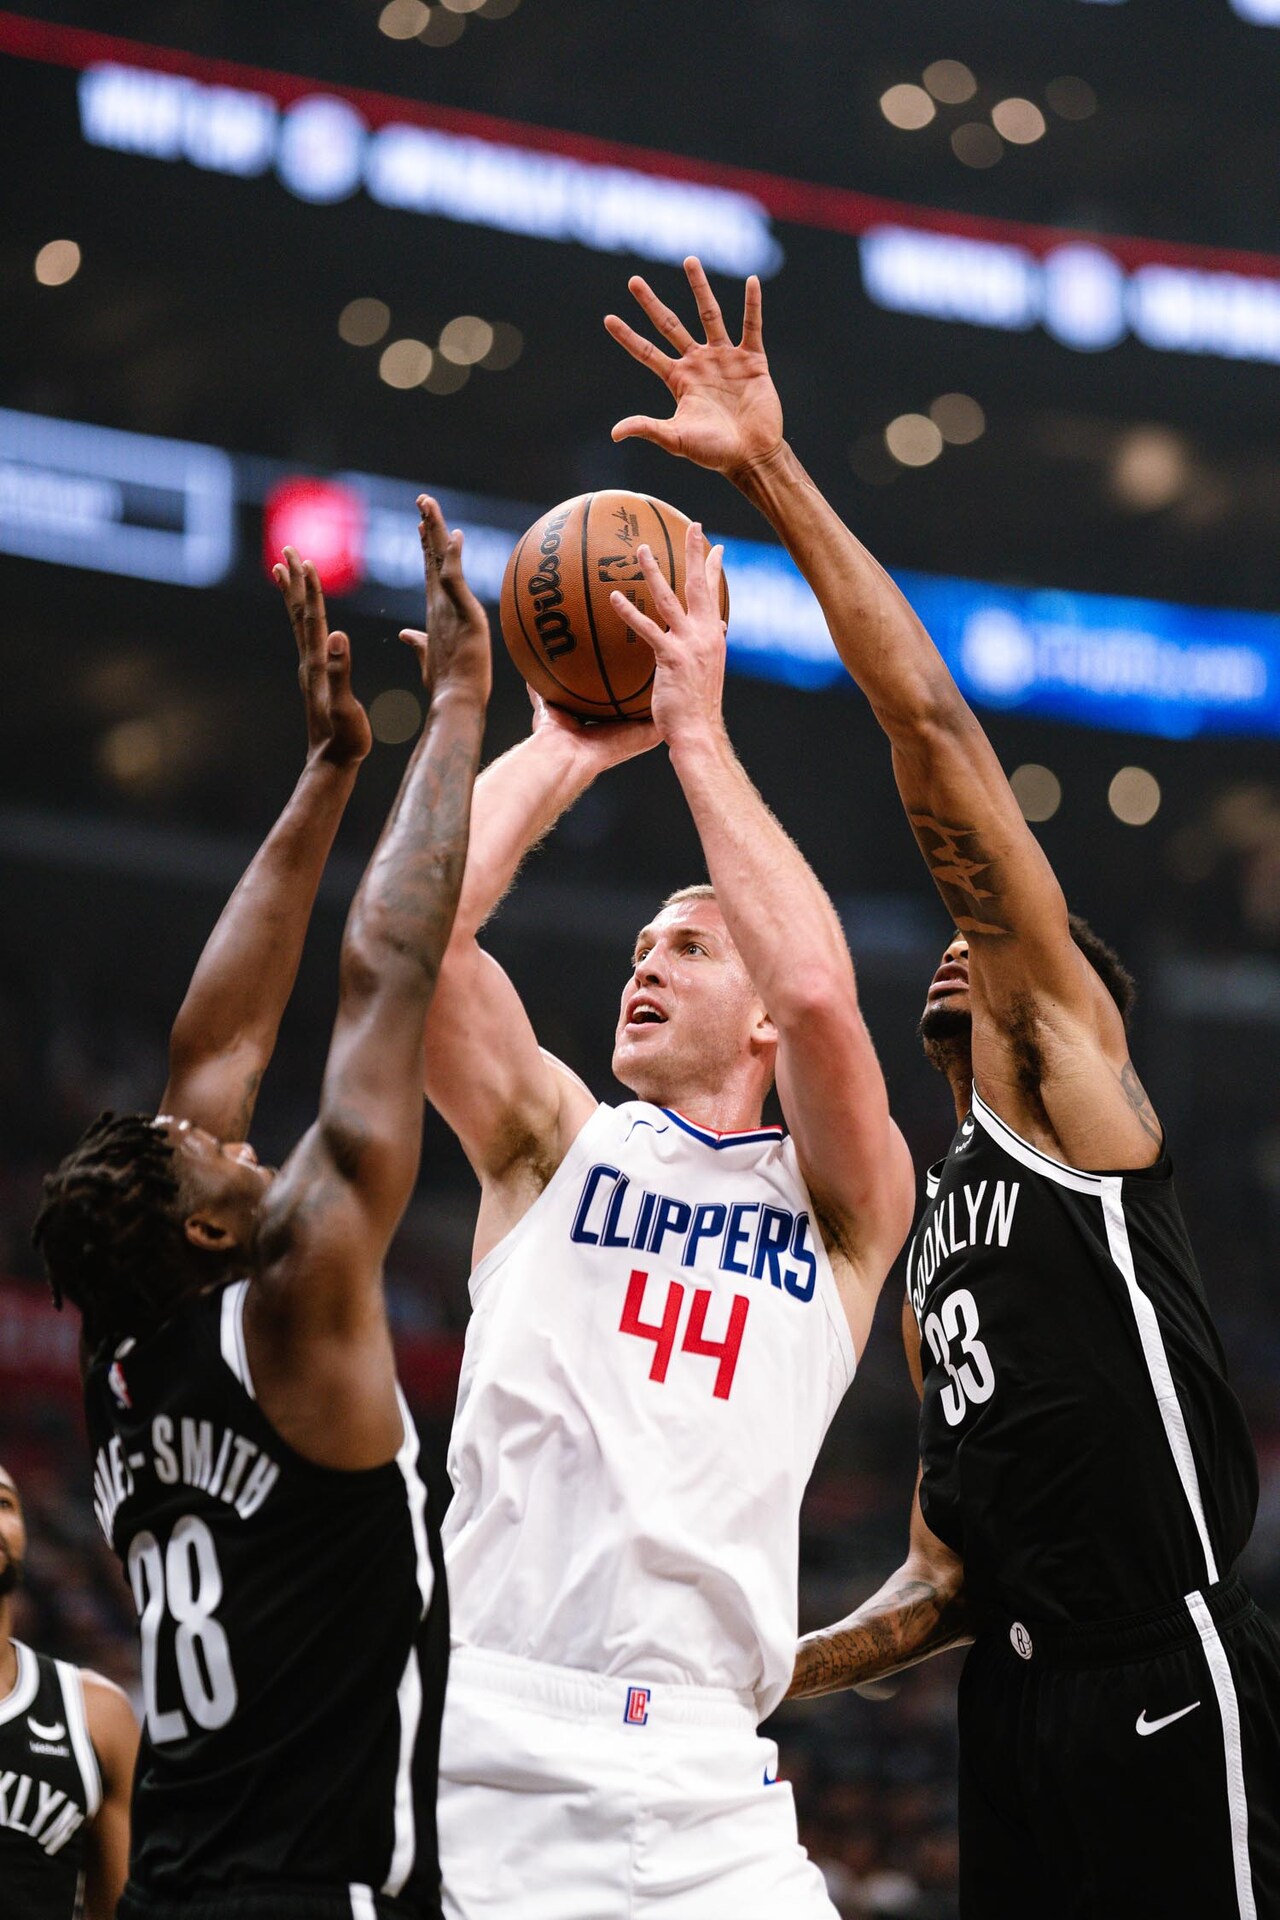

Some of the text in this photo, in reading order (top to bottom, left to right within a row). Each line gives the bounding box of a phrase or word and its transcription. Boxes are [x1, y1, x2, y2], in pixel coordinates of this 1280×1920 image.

[528, 511, 577, 661] Wilson
[570, 1163, 817, 1303] CLIPPERS
[619, 1269, 750, 1401] 44
[924, 1289, 996, 1426] 33
[128, 1515, 238, 1745] 28
